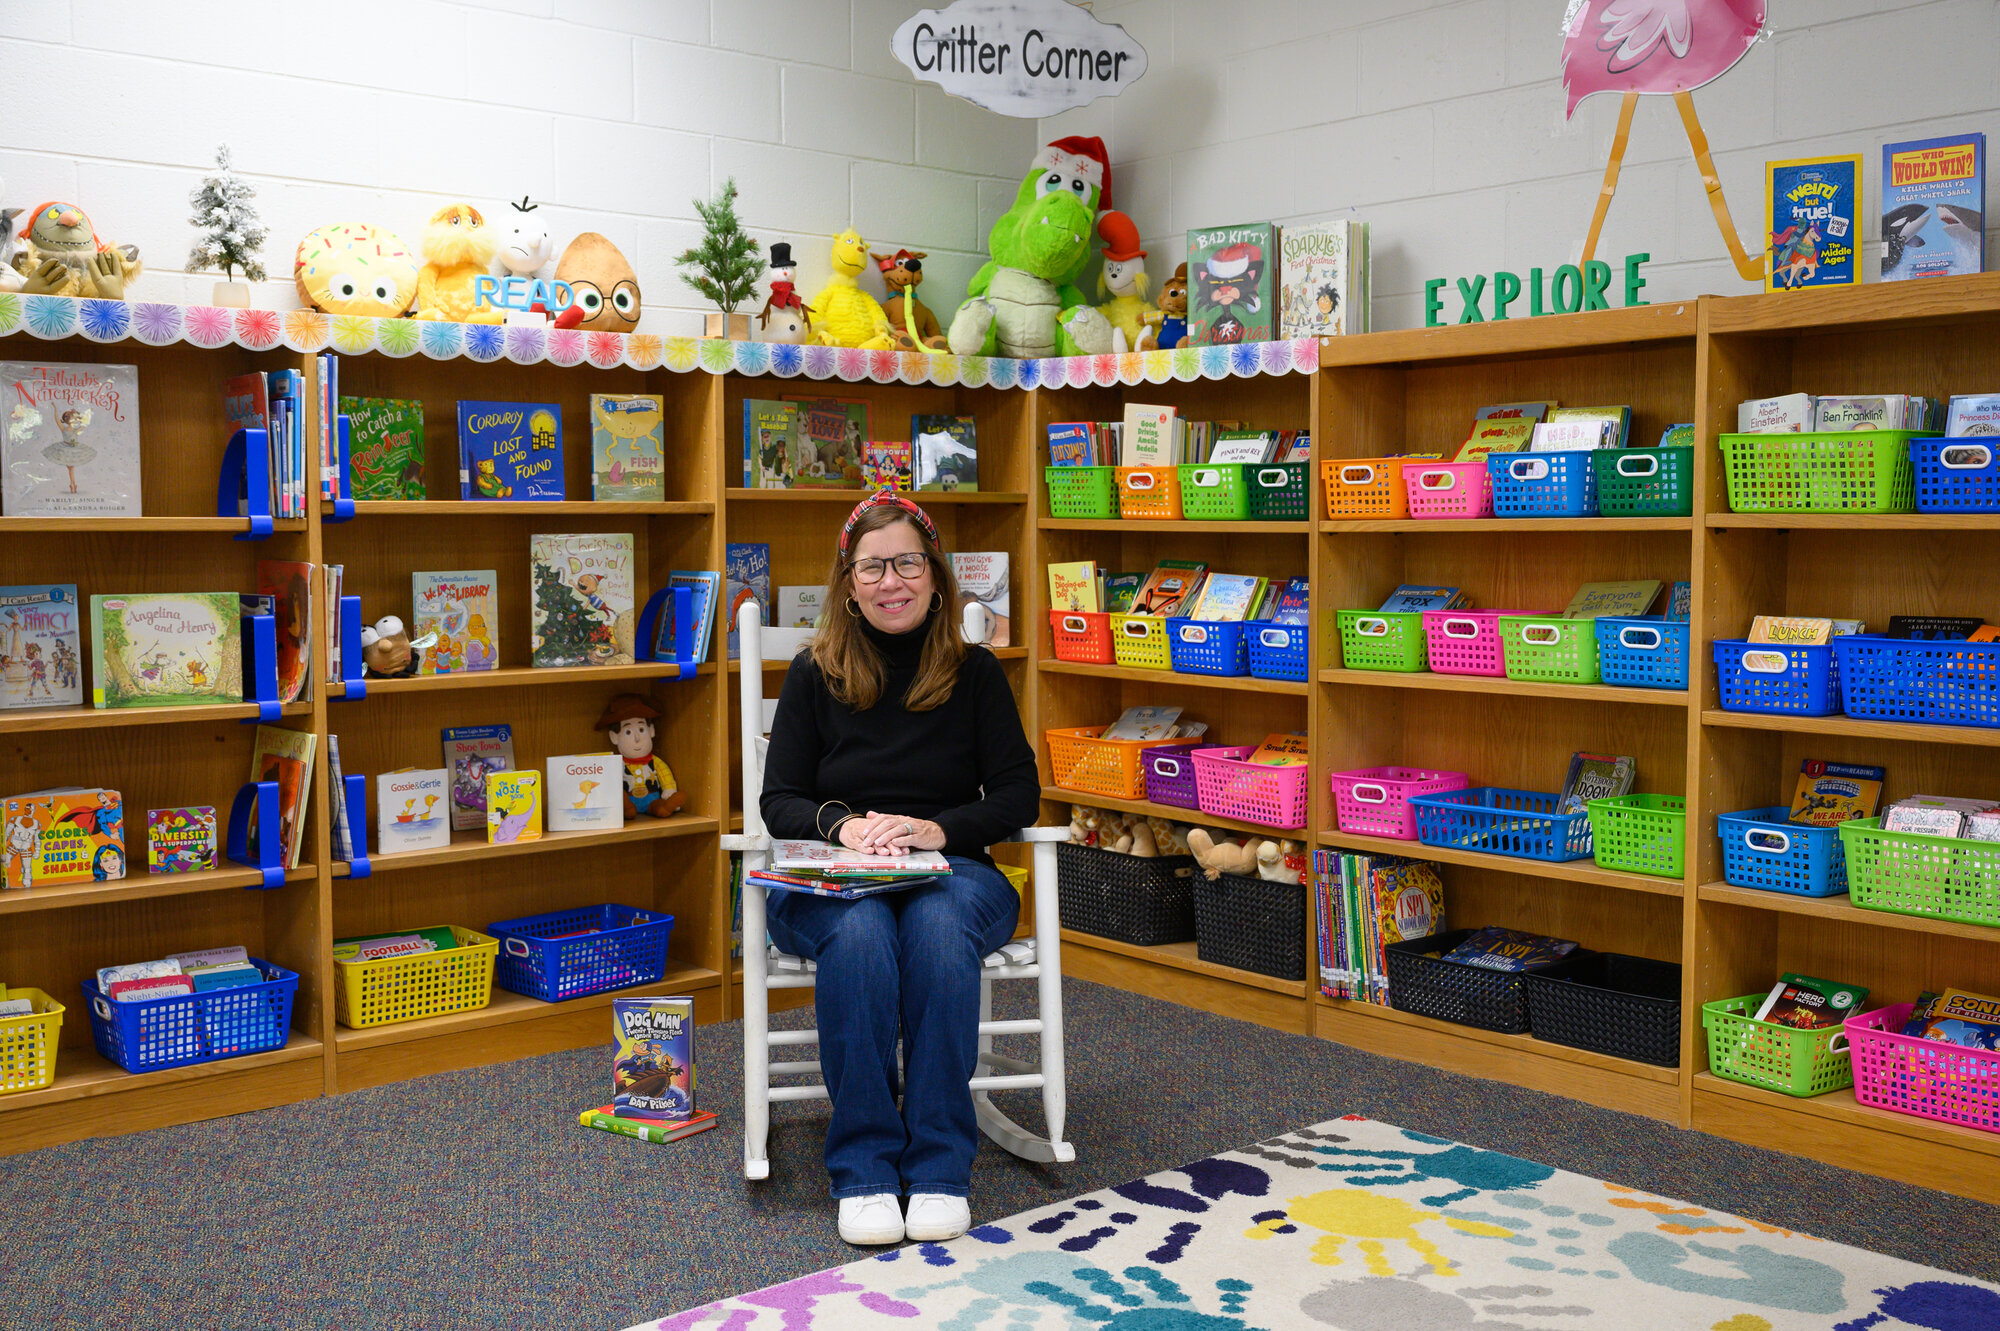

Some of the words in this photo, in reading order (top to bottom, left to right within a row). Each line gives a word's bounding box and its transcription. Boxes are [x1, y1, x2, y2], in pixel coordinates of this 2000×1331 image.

[913, 23, 1010, 74] Critter
[1023, 29, 1127, 82] Corner
[1922, 151, 1944, 160] WHO
[1894, 161, 1937, 184] WOULD
[1939, 153, 1973, 176] WIN?
[1786, 182, 1839, 203] weird
[1902, 184, 1927, 193] KILLER
[1930, 182, 1952, 190] WHALE
[1896, 194, 1918, 202] GREAT
[1921, 192, 1944, 200] WHITE
[1947, 188, 1971, 197] SHARK
[1805, 198, 1819, 206] but
[1792, 202, 1833, 220] true!
[1197, 232, 1226, 249] BAD
[1228, 230, 1268, 246] KITTY
[1821, 247, 1852, 258] Middle
[1290, 259, 1305, 271] First
[1306, 255, 1337, 266] Christmas
[1824, 256, 1846, 265] Ages
[475, 274, 574, 311] READ
[1425, 253, 1650, 328] EXPLORE
[1188, 319, 1270, 346] Christmas
[349, 408, 371, 429] How
[758, 412, 775, 422] Let's
[1758, 407, 1779, 417] Albert
[1823, 411, 1841, 422] Ben
[1843, 409, 1883, 421] Franklin?
[1959, 414, 1990, 422] Princess
[356, 430, 368, 443] to
[367, 408, 395, 434] Catch
[396, 411, 402, 421] a
[468, 411, 523, 435] CORDUROY
[1140, 420, 1157, 428] Good
[1750, 413, 1788, 429] Einstein?
[493, 435, 523, 456] LOST
[1138, 436, 1158, 445] Amelia
[1136, 444, 1158, 453] Bedelia
[1220, 447, 1239, 456] PINKY
[508, 450, 527, 464] AND
[630, 457, 658, 468] FISH
[514, 458, 552, 481] FOUND
[632, 477, 657, 487] SUN
[749, 548, 769, 574] Ho!
[963, 555, 976, 564] YOU
[966, 564, 988, 572] MOOSE
[424, 587, 436, 602] We
[455, 584, 490, 602] LIBRARY
[799, 591, 816, 602] Gus
[1055, 590, 1068, 602] Dog
[1585, 591, 1642, 601] Everyone
[1282, 595, 1303, 607] Pete
[1401, 597, 1433, 606] FOX
[24, 611, 71, 631] NANCY
[126, 606, 181, 626] Angelina
[154, 623, 174, 633] and
[177, 620, 216, 635] Henry
[1767, 625, 1819, 640] LUNCH
[456, 742, 477, 753] Shoe
[479, 740, 502, 751] Town
[566, 763, 604, 776] Gossie
[1813, 763, 1820, 774] 1
[1849, 768, 1875, 776] READING
[495, 784, 521, 798] NOSE
[1813, 811, 1829, 820] WE
[1830, 811, 1848, 820] ARE
[38, 827, 92, 840] COLORS,
[151, 830, 214, 842] DIVERSITY
[44, 839, 87, 851] CAPES,
[44, 851, 77, 863] SIZES
[81, 850, 88, 859] &
[43, 861, 91, 875] SHAPES
[1406, 893, 1426, 916] SPY
[363, 941, 421, 958] FOOTBALL
[1497, 943, 1536, 959] SPY
[1794, 997, 1823, 1008] FACTORY
[1796, 991, 1826, 1004] HERO
[1837, 994, 1847, 1004] 2
[623, 1011, 652, 1029] DOG
[653, 1012, 681, 1029] MAN
